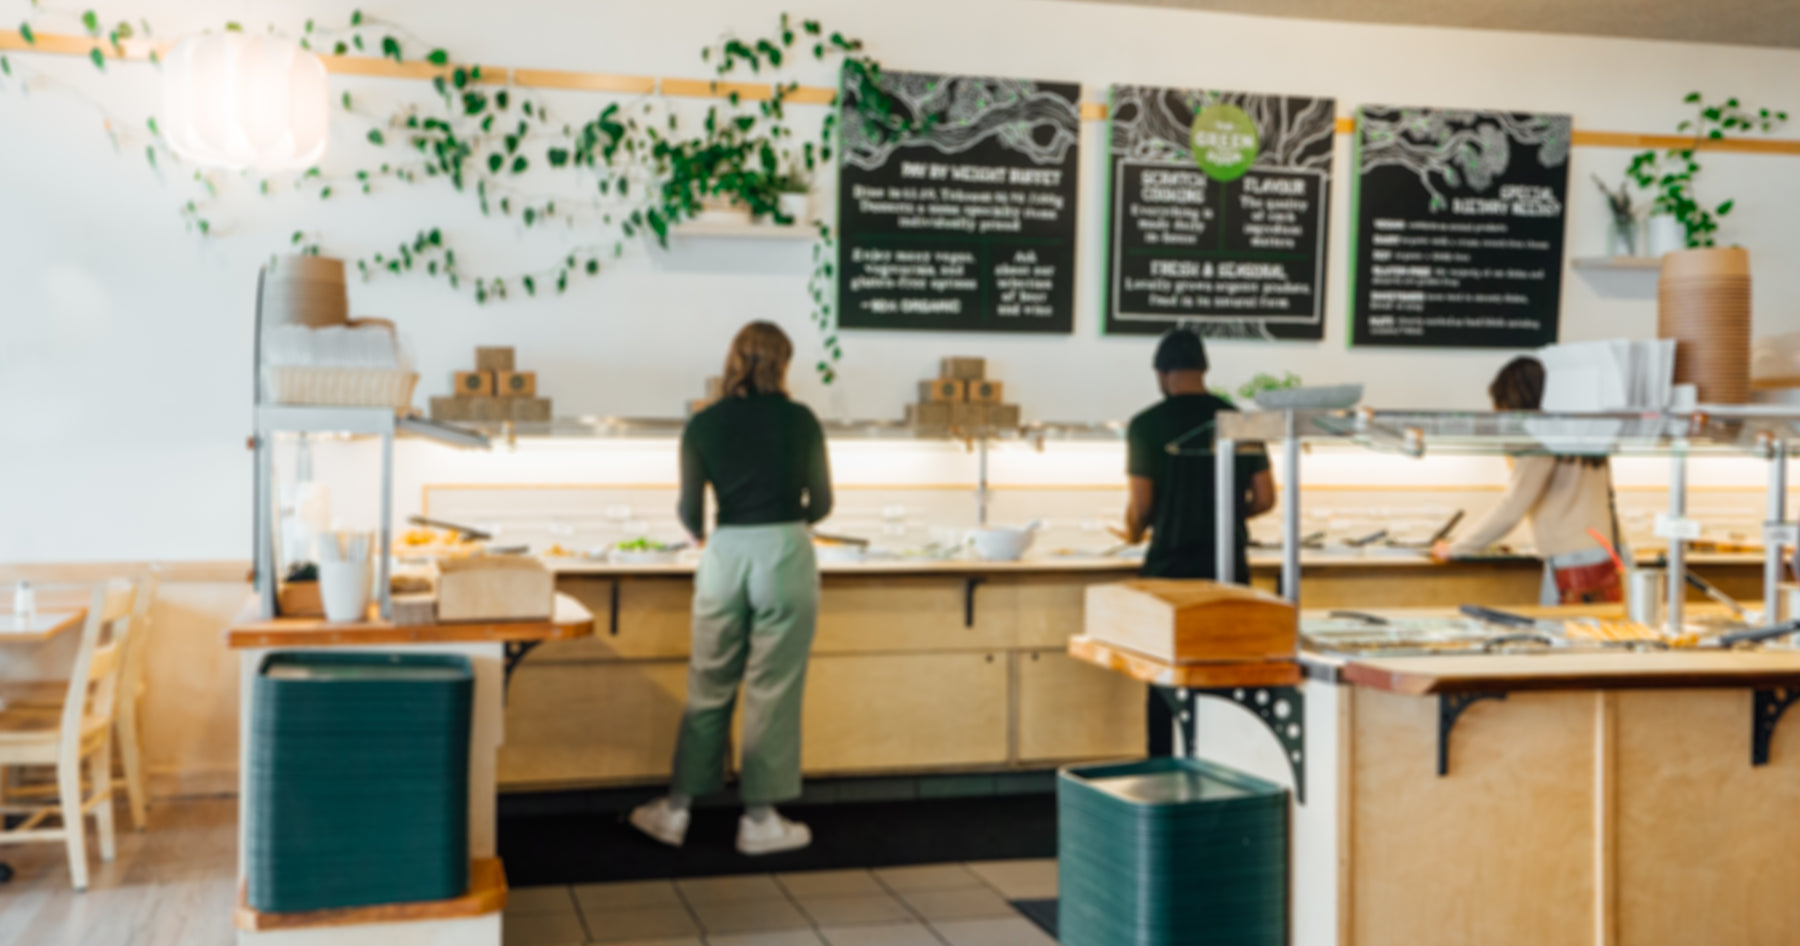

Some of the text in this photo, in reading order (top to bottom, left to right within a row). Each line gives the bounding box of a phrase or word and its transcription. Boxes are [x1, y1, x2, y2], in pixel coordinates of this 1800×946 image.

[1195, 132, 1254, 149] GREEN
[1206, 151, 1244, 166] DOOR
[902, 162, 1062, 186] PAY BY WEIGHT BUFFET
[1141, 170, 1206, 187] SCRATCH
[1243, 177, 1306, 195] FLAVOUR
[1500, 186, 1555, 201] SPECIAL
[852, 185, 885, 198] Dine
[888, 187, 901, 199] in
[940, 188, 992, 203] Takeout
[1141, 187, 1205, 203] COOKING
[860, 199, 914, 213] Desserts
[928, 204, 960, 215] some
[963, 203, 1021, 219] specialty
[1023, 206, 1057, 219] items
[1240, 195, 1308, 212] The quality
[1453, 199, 1561, 216] DIETARY NEEDS?
[1131, 204, 1213, 219] Everything is
[1251, 209, 1296, 222] of each
[897, 216, 1021, 232] individually priced
[1138, 218, 1205, 233] made daily
[1243, 222, 1302, 236] ingredient
[1250, 236, 1295, 248] matters
[851, 248, 891, 262] Enjoy
[895, 251, 932, 263] many
[1014, 251, 1038, 263] Ask
[940, 264, 964, 276] and
[994, 263, 1055, 276] about our
[1150, 260, 1288, 279] FRESH & SEASONAL
[850, 276, 978, 292] gluten-free options
[996, 277, 1053, 289] selection
[1124, 277, 1171, 293] Locally
[1174, 282, 1212, 294] grown
[1214, 280, 1259, 295] organic
[1001, 290, 1048, 302] of beer
[1149, 293, 1177, 306] Food
[1214, 295, 1256, 308] natural
[900, 299, 961, 313] ORGANIC
[997, 303, 1054, 316] and wine
